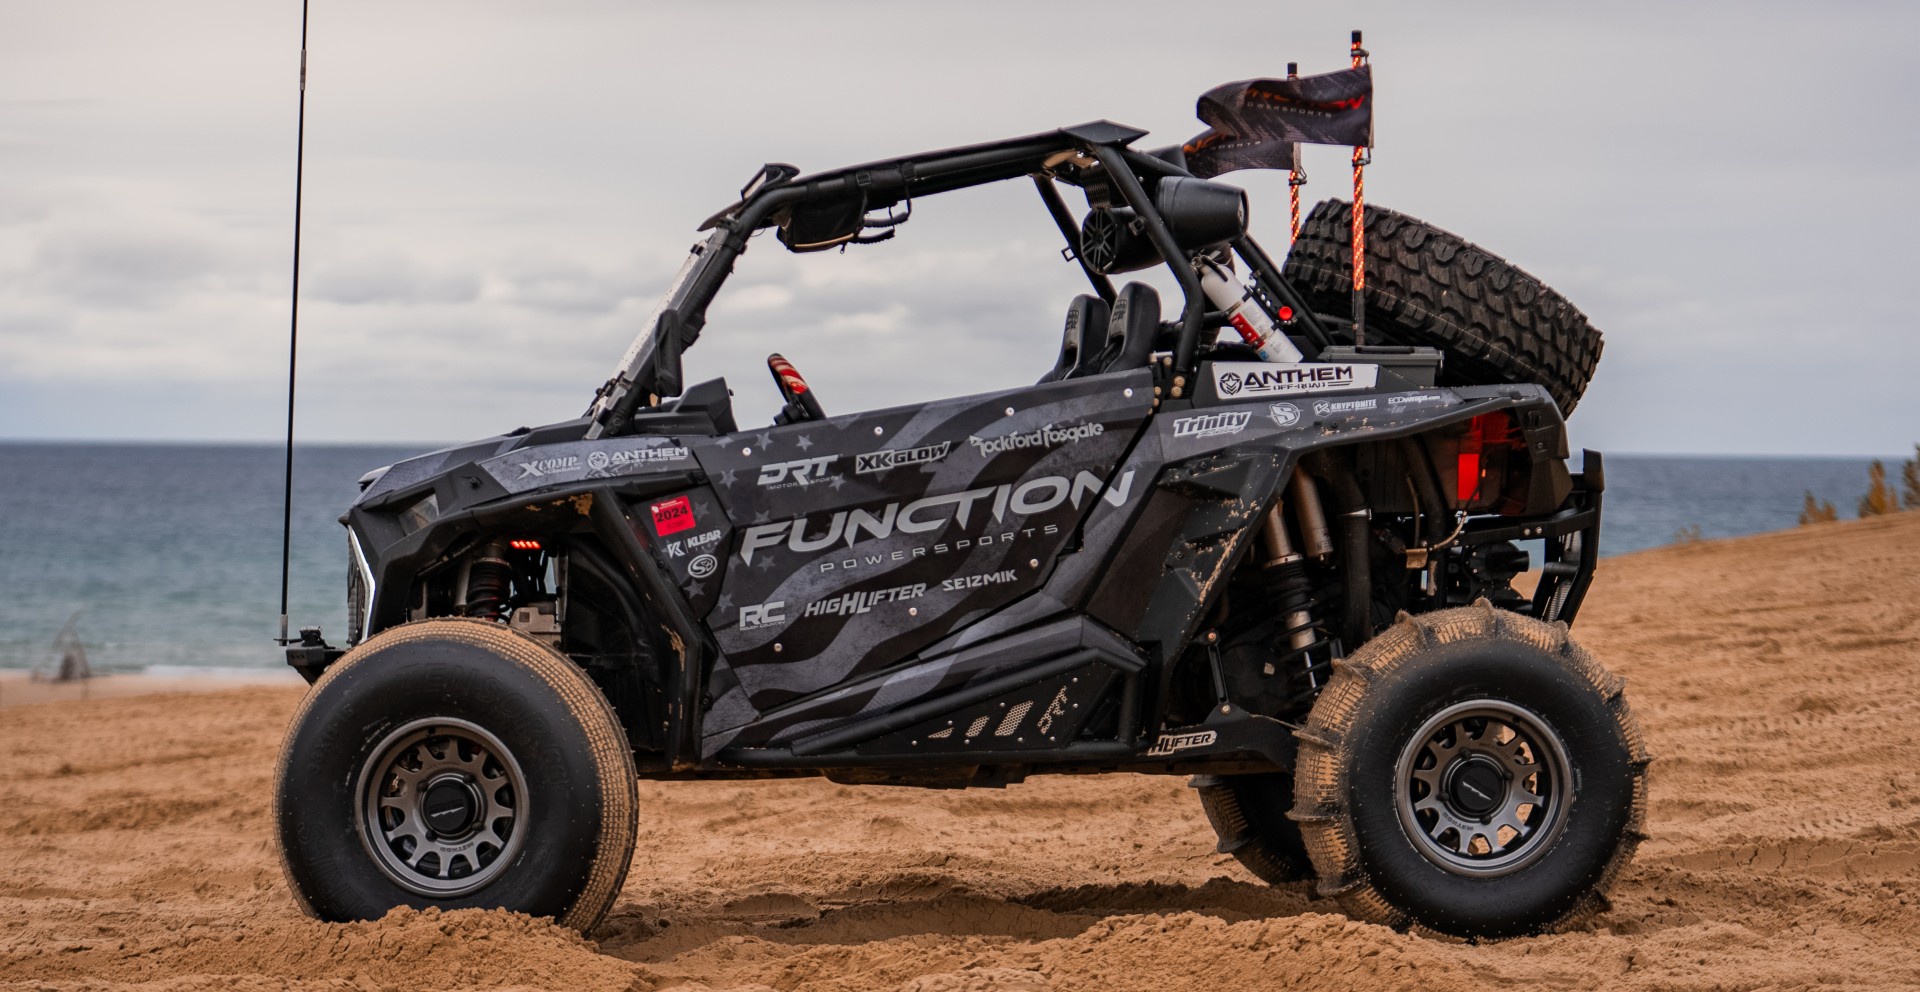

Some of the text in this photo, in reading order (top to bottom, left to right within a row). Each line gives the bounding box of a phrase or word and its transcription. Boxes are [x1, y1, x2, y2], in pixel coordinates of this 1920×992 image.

[1244, 365, 1353, 388] ANTHEM
[1331, 399, 1377, 410] KRYPTONITE
[1174, 412, 1252, 436] Trinity
[611, 447, 689, 462] ANTHEM
[757, 454, 839, 486] DRT
[655, 505, 689, 523] 2024
[739, 470, 1136, 567] FUNCTION
[687, 529, 722, 548] KLEAR
[820, 524, 1059, 573] POWERSPORTS
[942, 569, 1018, 591] SEIZMIK
[740, 601, 786, 628] RC
[1149, 733, 1212, 753] HLIFTER
